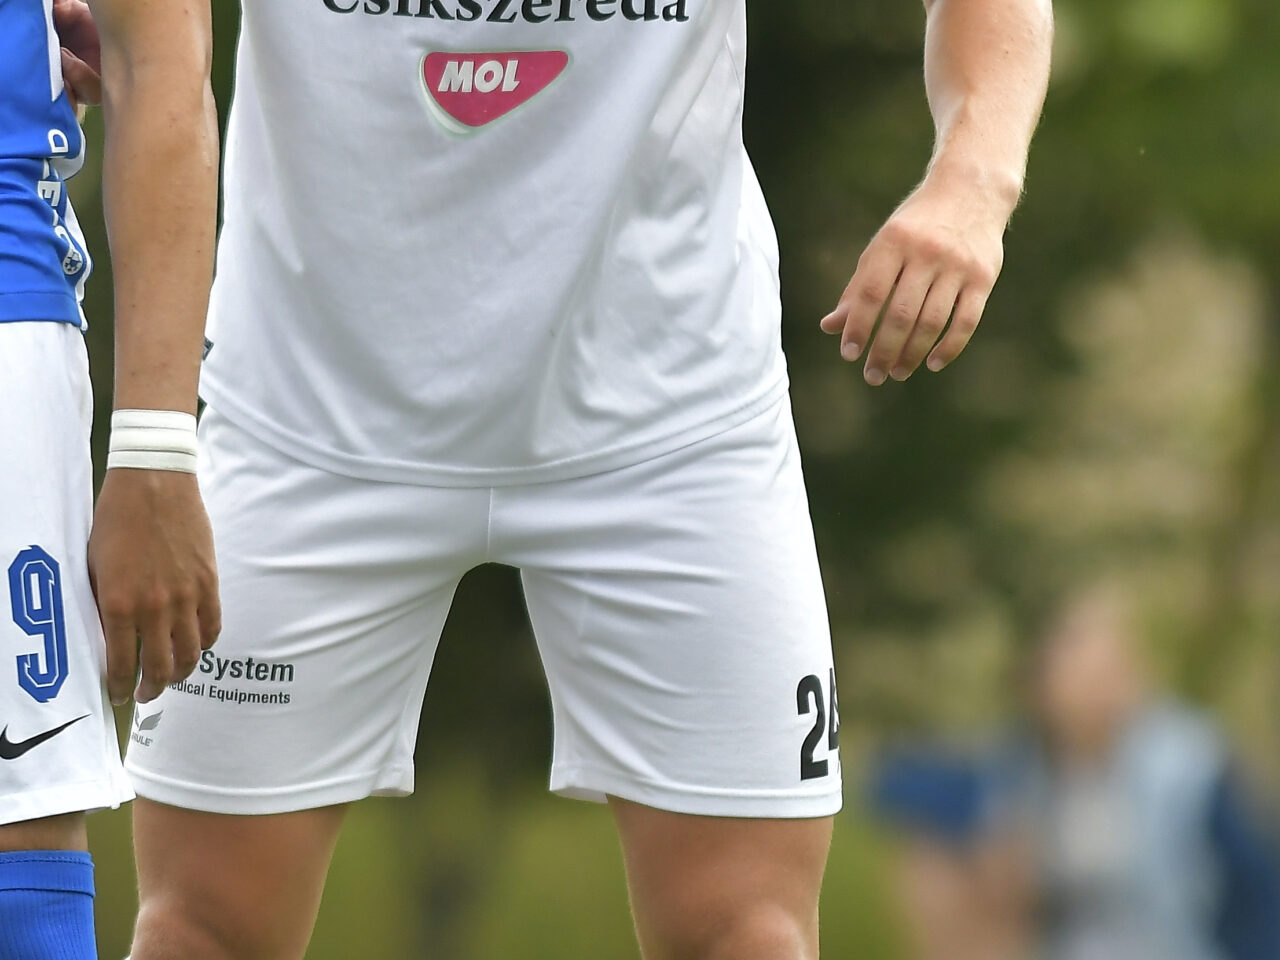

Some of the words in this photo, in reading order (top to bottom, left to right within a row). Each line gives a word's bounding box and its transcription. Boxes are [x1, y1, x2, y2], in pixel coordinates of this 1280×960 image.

[437, 60, 520, 93] MOL
[7, 544, 70, 703] 9
[167, 681, 205, 696] edical
[209, 686, 291, 705] Equipments
